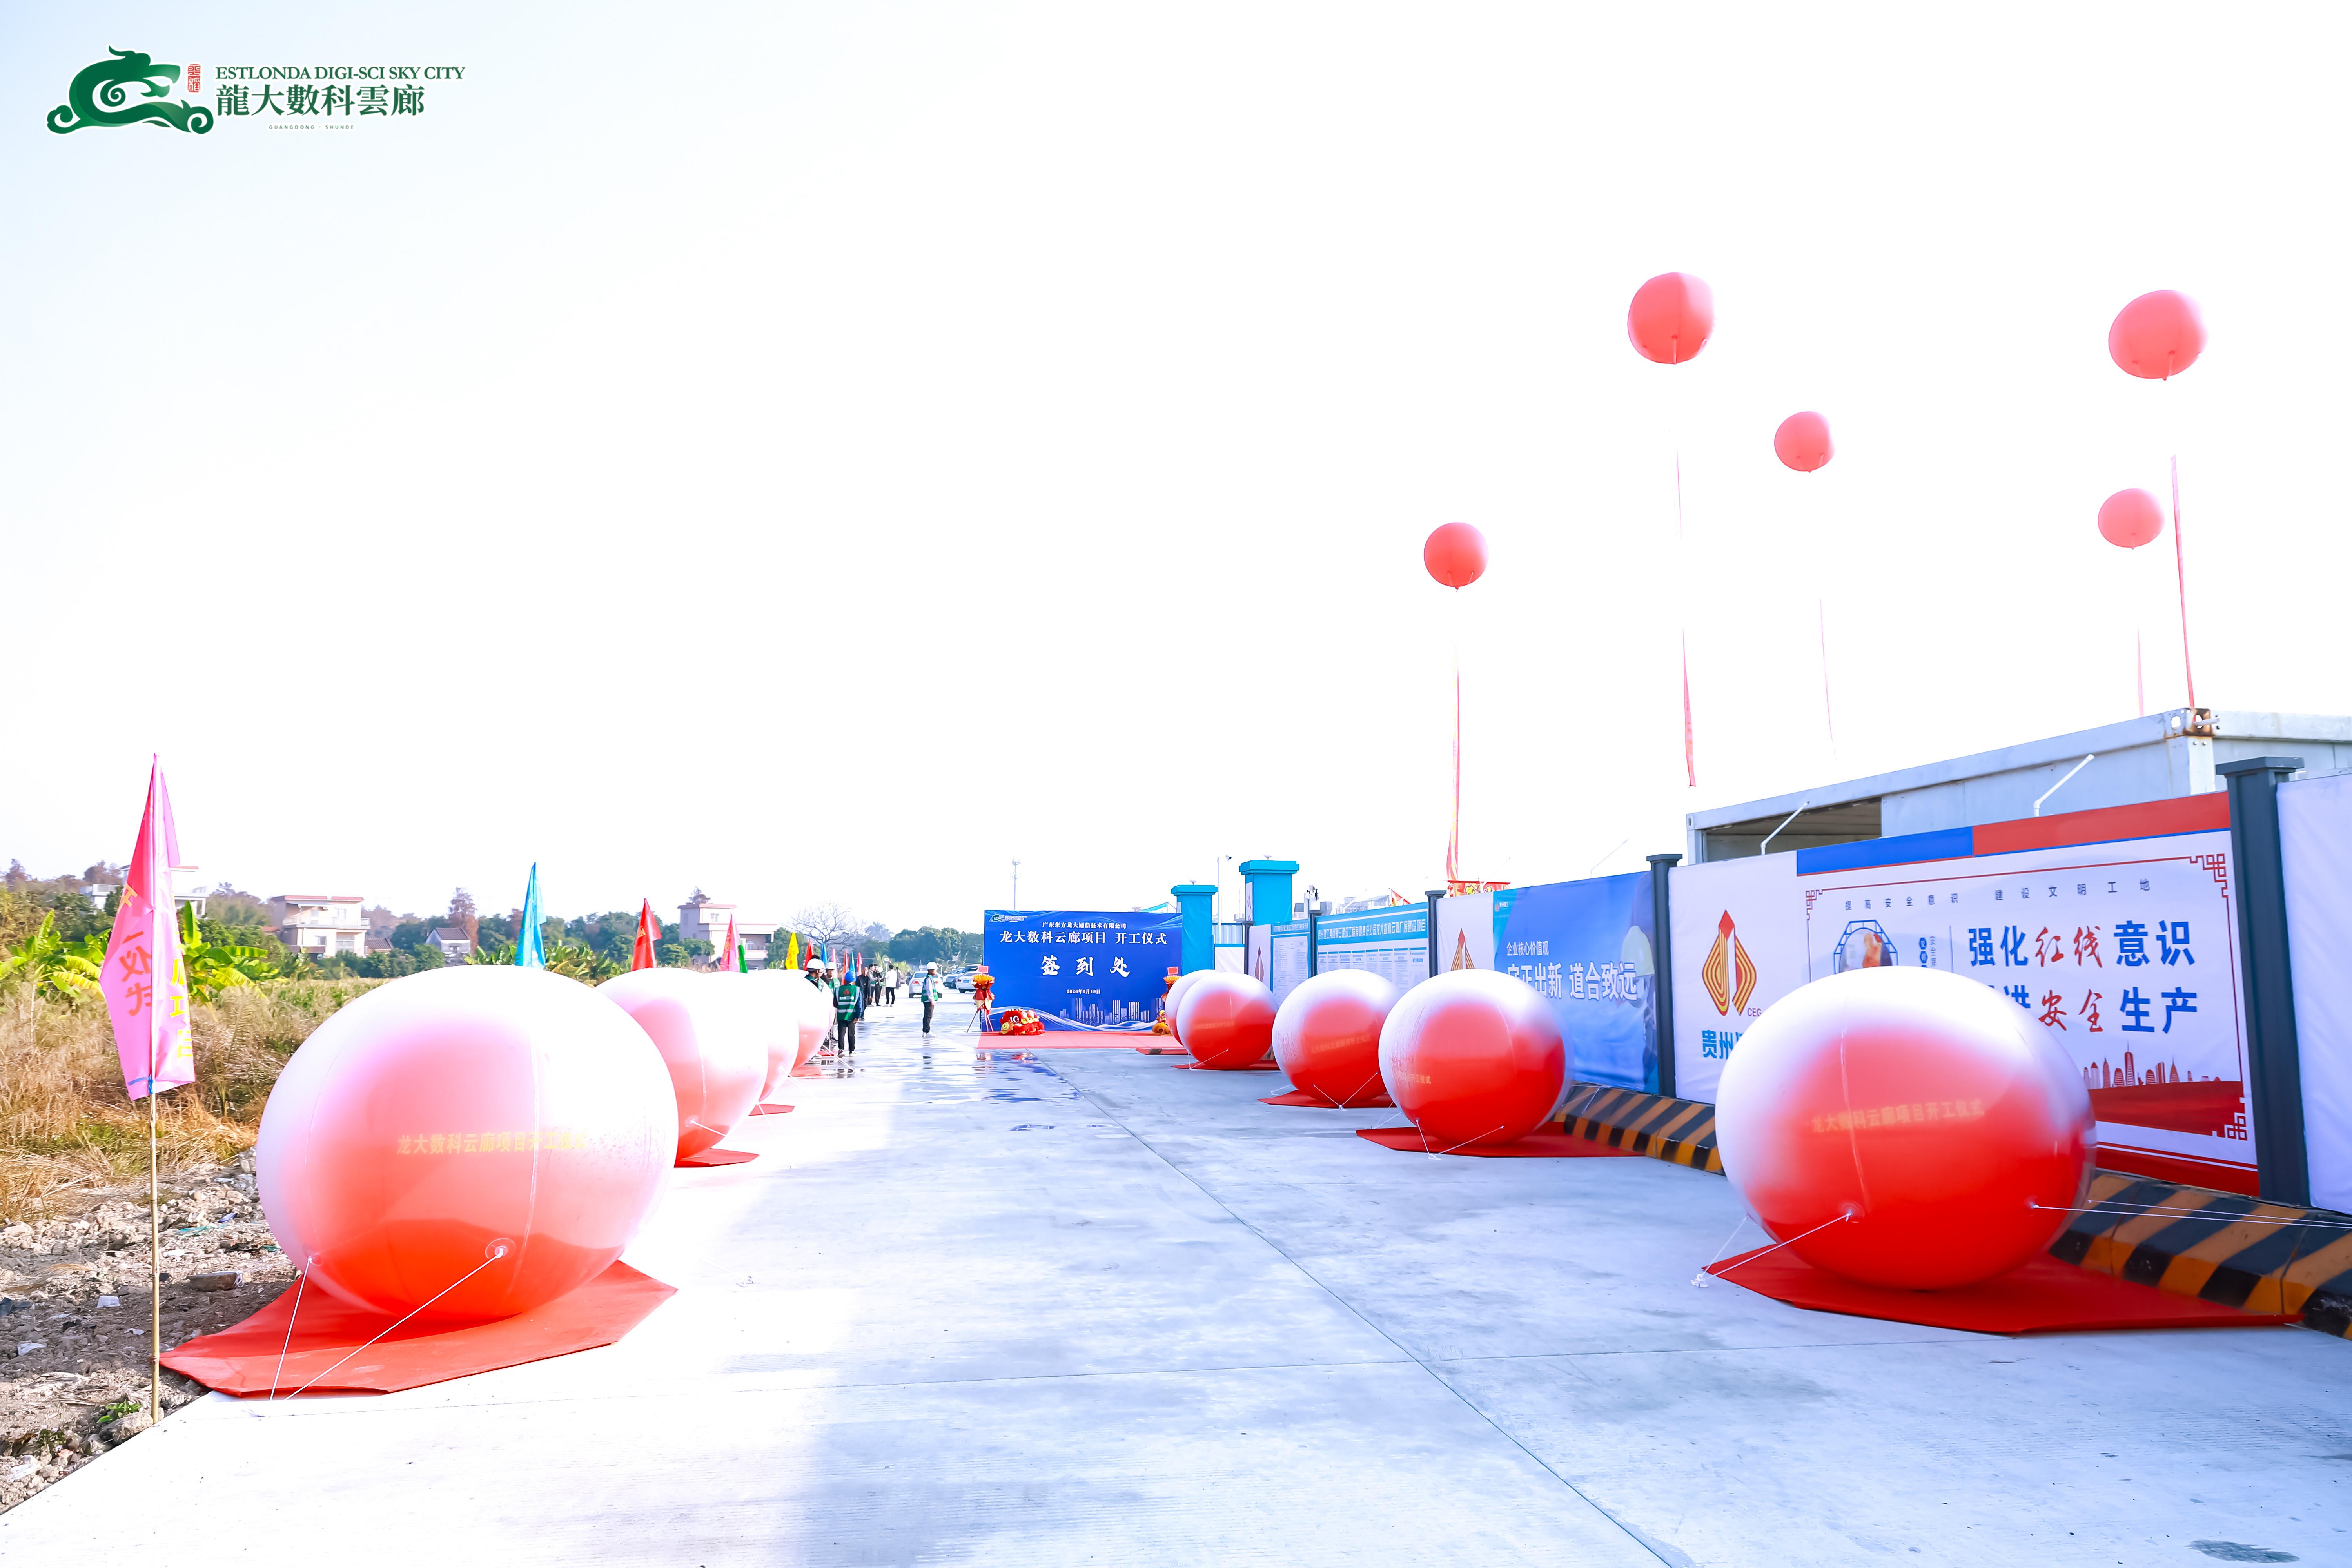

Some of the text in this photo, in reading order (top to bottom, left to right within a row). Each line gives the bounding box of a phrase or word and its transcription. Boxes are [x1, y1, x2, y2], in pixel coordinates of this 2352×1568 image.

[1845, 878, 2150, 911] 提高安全意识 建设文明工地
[1000, 930, 1167, 945] 龙大数科云廊项目 开工仪式
[1506, 940, 1549, 956] 企业核心价值观
[1968, 920, 2195, 968] 强化红线意识
[1040, 954, 1130, 978] 签到处
[1569, 961, 1637, 1000] 道合致远
[1748, 1008, 1762, 1017] CEG
[1987, 985, 2198, 1034] 安全生产
[1702, 1030, 1744, 1060] 贵州
